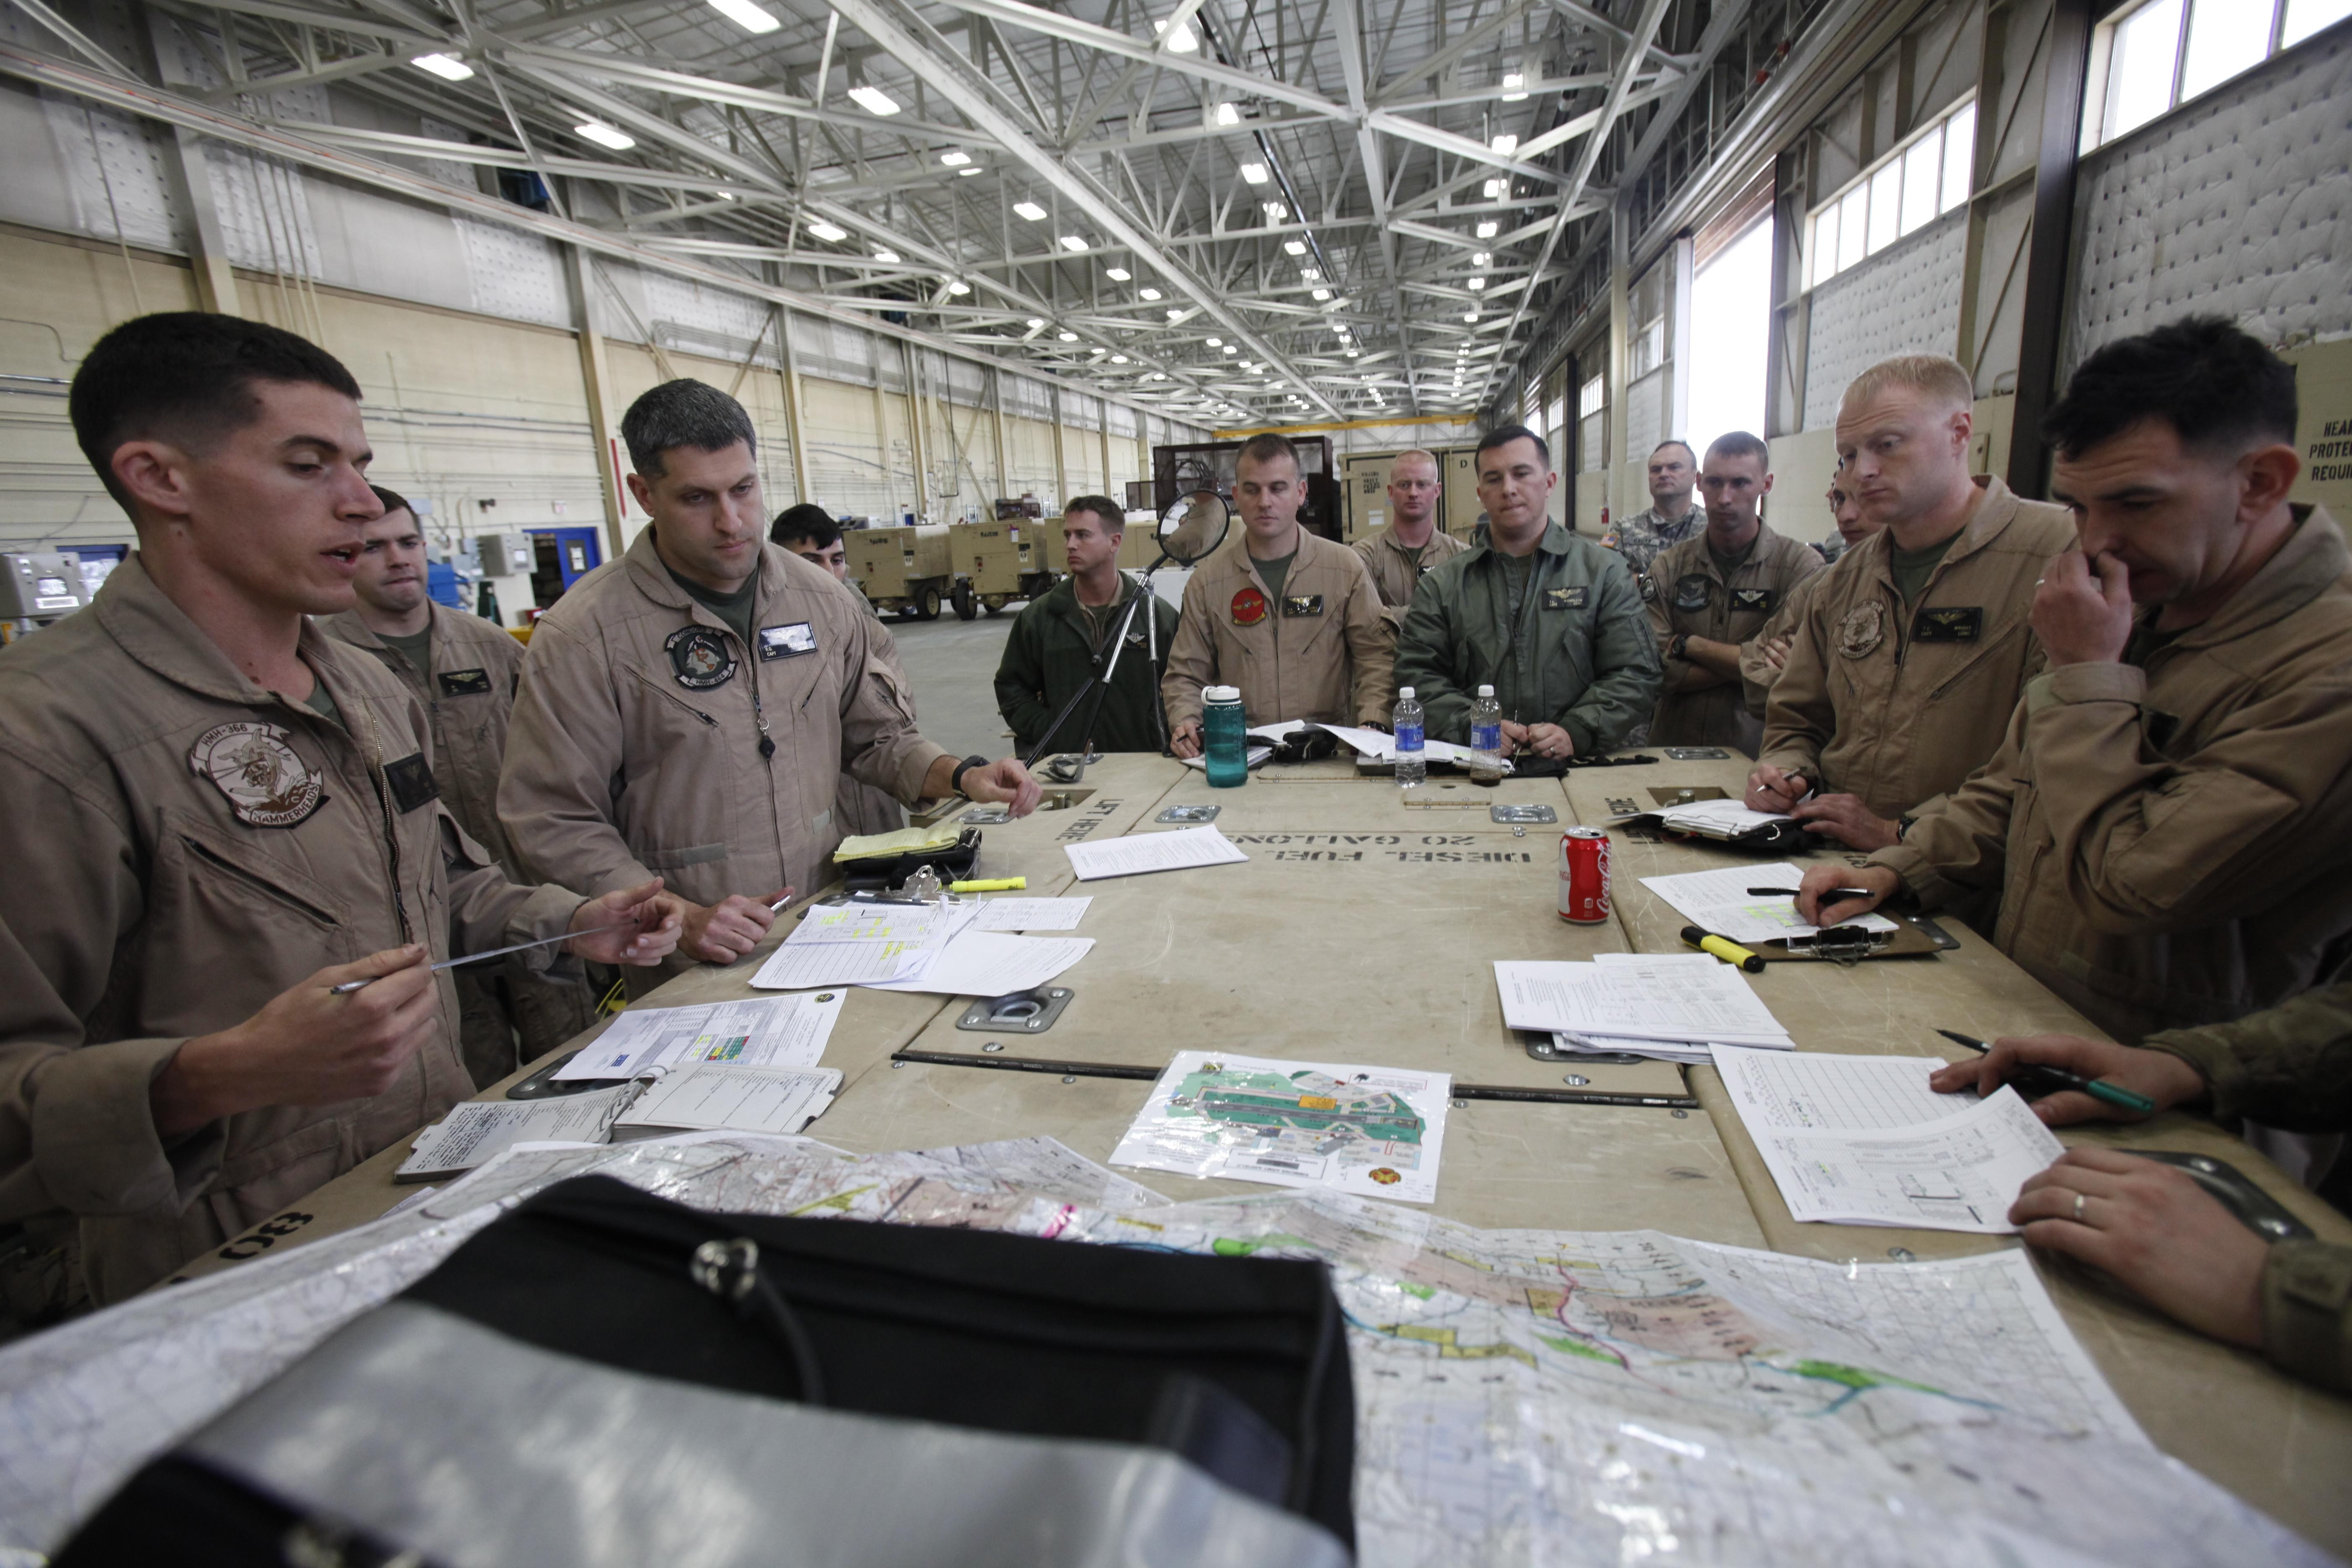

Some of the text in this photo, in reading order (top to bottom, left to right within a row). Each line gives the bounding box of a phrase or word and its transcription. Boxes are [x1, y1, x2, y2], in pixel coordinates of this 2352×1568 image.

[1460, 459, 1467, 468] D
[201, 724, 248, 747] HMH-366
[253, 786, 318, 824] HAMMERHEADS
[1264, 851, 1530, 862] DIESEL FUEL
